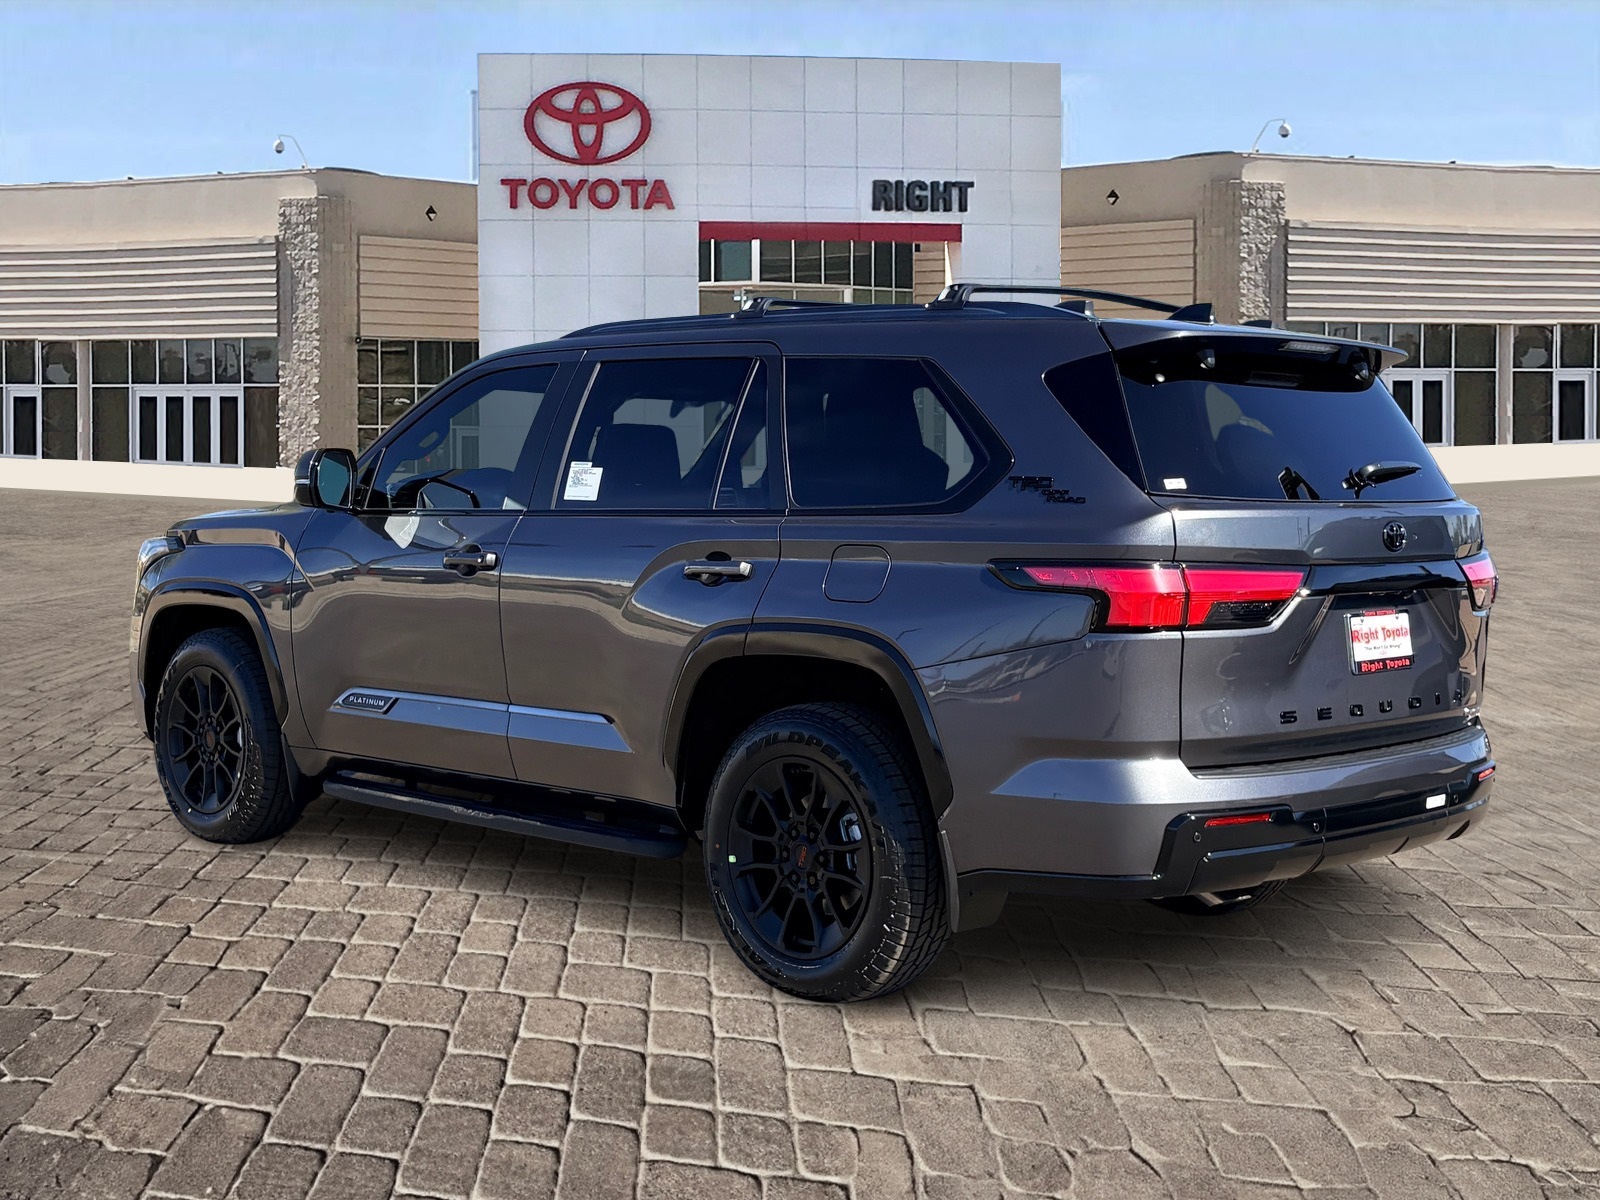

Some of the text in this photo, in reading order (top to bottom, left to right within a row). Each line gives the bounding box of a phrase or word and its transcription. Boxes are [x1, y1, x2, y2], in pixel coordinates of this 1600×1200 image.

[500, 178, 675, 210] TOYOTA
[872, 180, 975, 212] RIGHT
[1008, 476, 1055, 491] TRD
[1352, 625, 1409, 644] Right Toyota
[1361, 658, 1410, 672] Right Toyota
[349, 695, 385, 706] PLATINUM
[1280, 689, 1463, 725] SEQUOIA
[745, 731, 868, 792] WILDPEAK
